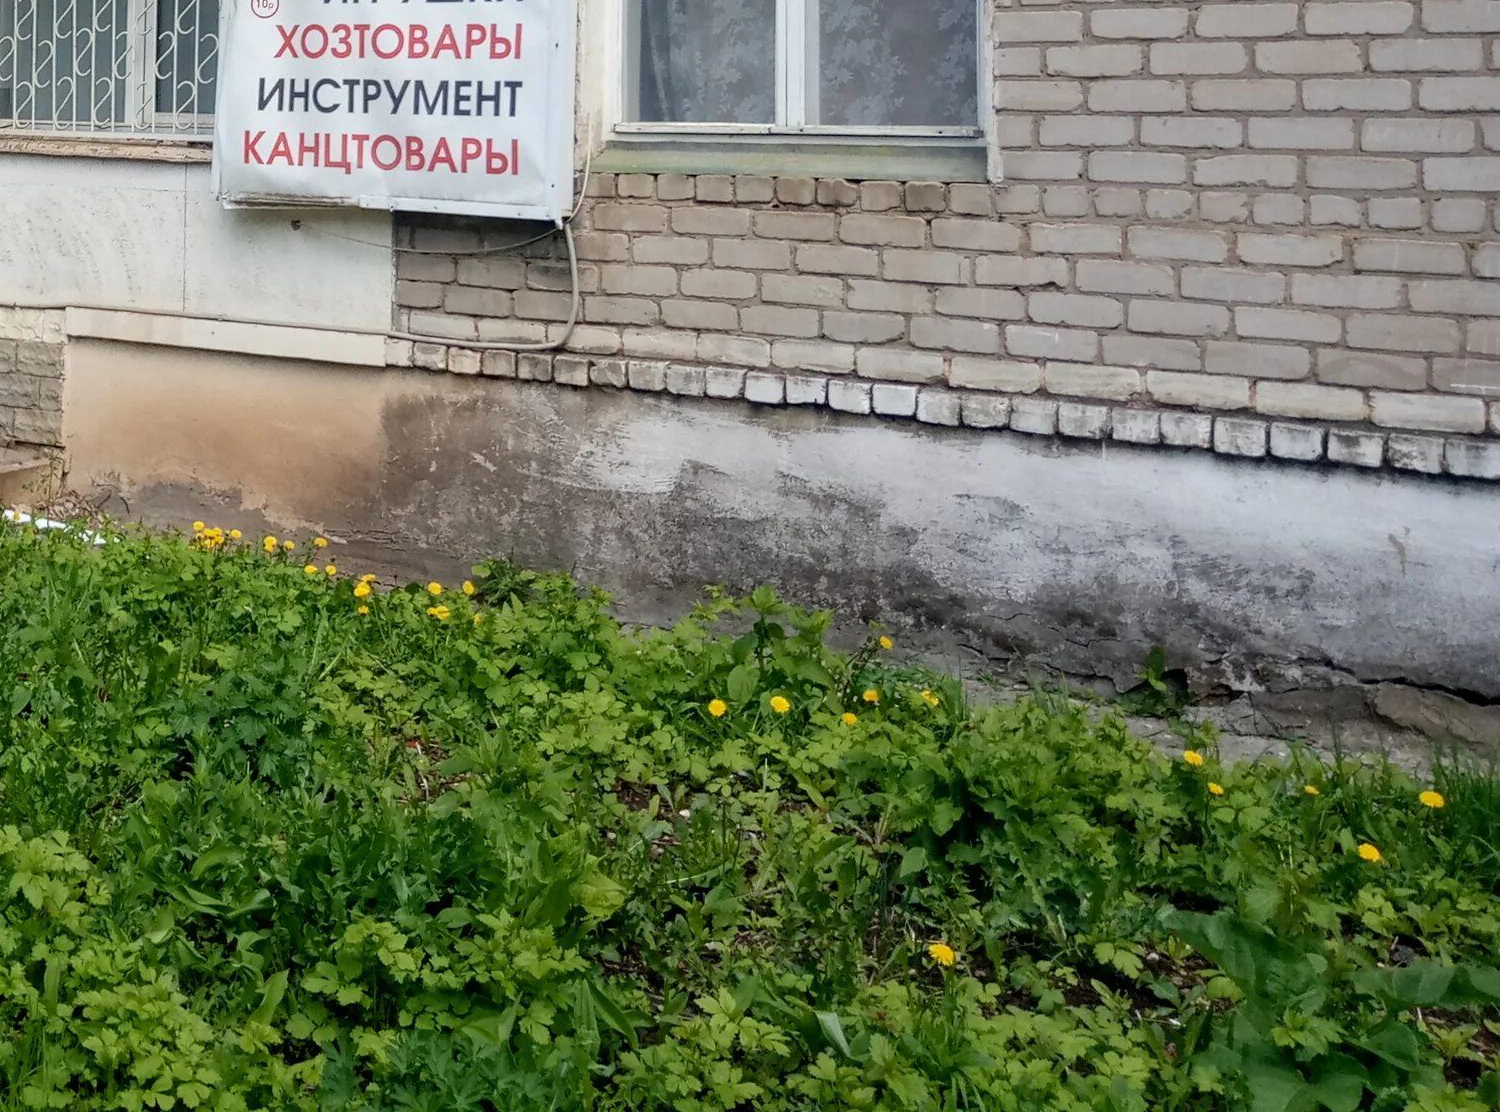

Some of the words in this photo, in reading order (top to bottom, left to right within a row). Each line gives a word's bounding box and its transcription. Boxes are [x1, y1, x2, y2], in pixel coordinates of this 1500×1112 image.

[274, 23, 522, 60] ХОЗТОВАРЫ
[257, 77, 523, 118] ИНСТРУМЕНТ
[243, 130, 520, 176] КАНЦТОВАРЫ
